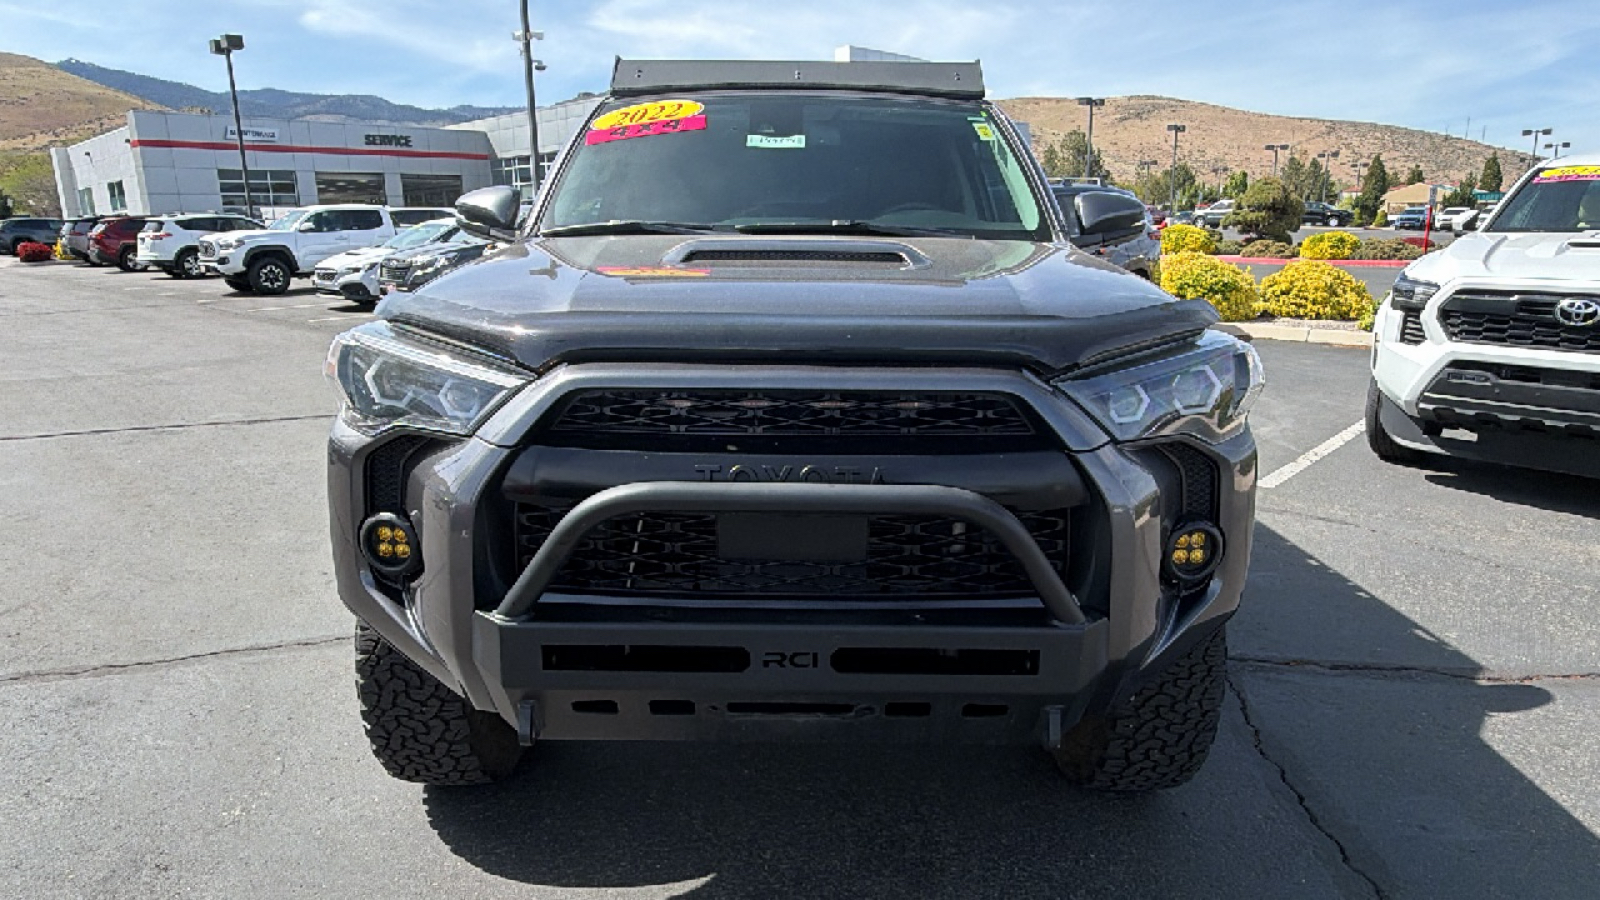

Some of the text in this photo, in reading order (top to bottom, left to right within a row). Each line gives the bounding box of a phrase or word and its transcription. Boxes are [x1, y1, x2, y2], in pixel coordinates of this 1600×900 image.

[610, 103, 684, 127] 2022
[229, 129, 276, 138] MANTENANCE
[364, 134, 413, 148] SERVICE
[762, 651, 819, 669] RCI
